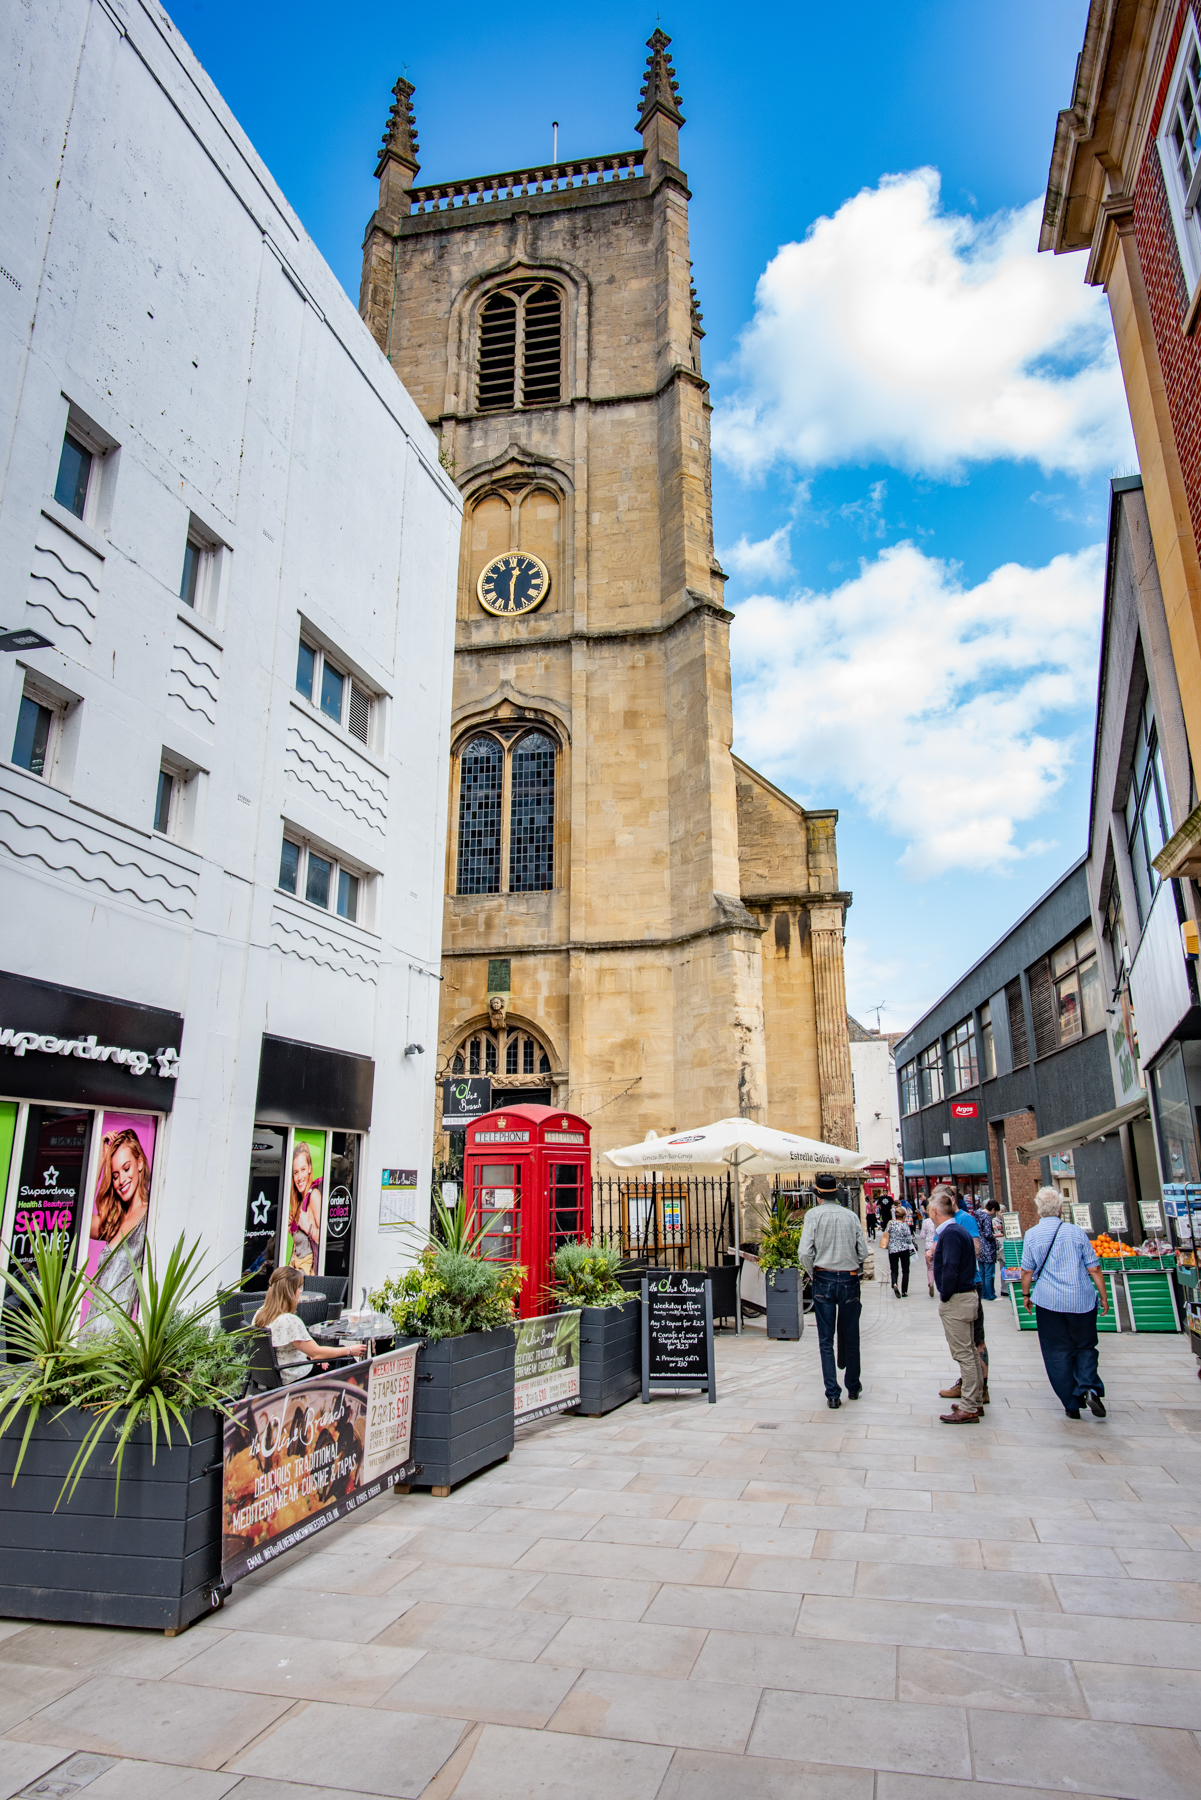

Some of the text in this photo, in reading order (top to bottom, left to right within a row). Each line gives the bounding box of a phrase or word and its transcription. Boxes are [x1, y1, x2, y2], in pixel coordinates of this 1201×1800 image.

[0, 1027, 151, 1075] uperdrug
[456, 1078, 478, 1100] Olive
[479, 1132, 526, 1142] TELEPHONE
[546, 1132, 584, 1143] TELEPHONE
[790, 1150, 834, 1164] Estrella Galicia
[20, 1186, 76, 1197] Superdrug
[330, 1196, 345, 1205] order
[329, 1206, 349, 1217] collect
[15, 1210, 72, 1232] save
[12, 1231, 70, 1255] more
[244, 1230, 275, 1238] Superdrug
[658, 1275, 677, 1293] Olive
[653, 1301, 701, 1311] Weekday offers
[650, 1320, 660, 1328] Any
[666, 1320, 682, 1329] tapas
[658, 1331, 677, 1339] Carafe
[679, 1331, 685, 1339] of
[373, 1356, 412, 1377] WEEKDAY OFFERS
[515, 1362, 537, 1379] TERRANEAN
[373, 1375, 410, 1401] 5 TAPAS £25
[371, 1405, 377, 1427] 2
[396, 1395, 408, 1418] £10
[249, 1389, 346, 1458] the Olive Branch
[396, 1420, 407, 1439] £25
[254, 1442, 339, 1498] DELICIOUS TRADITIONAL
[232, 1453, 357, 1534] MEDITERRANEAN CUISINE & TAPAS
[246, 1556, 264, 1570] EMAIL
[346, 1498, 356, 1511] CALL
[356, 1491, 368, 1506] 01905
